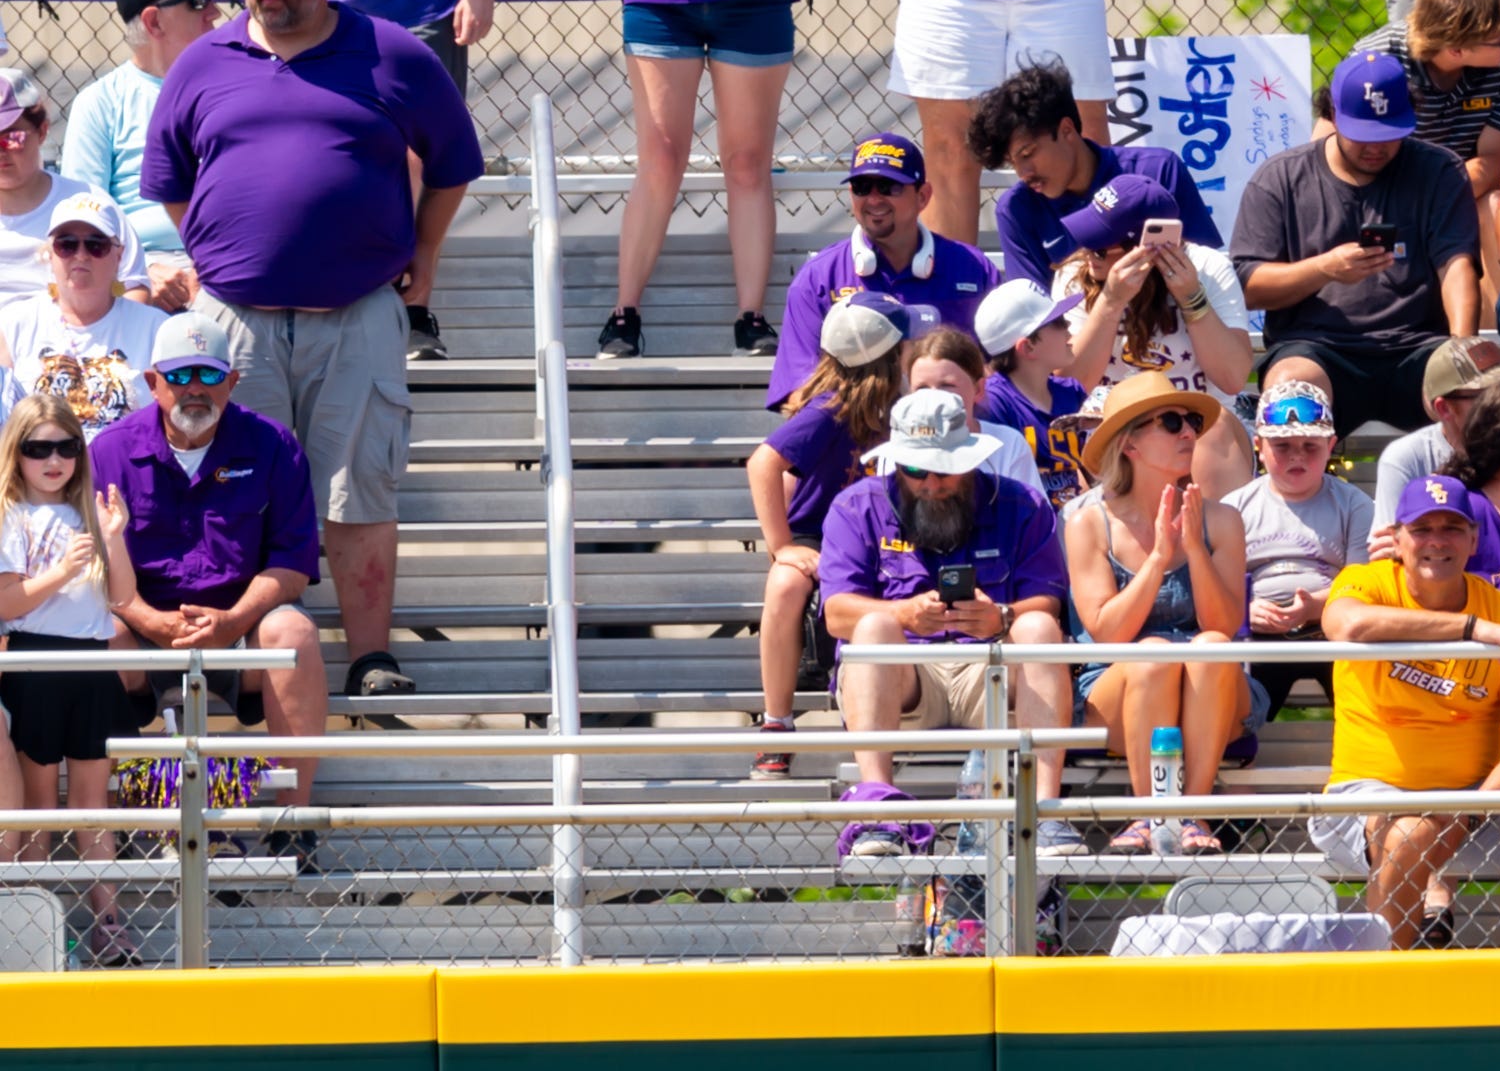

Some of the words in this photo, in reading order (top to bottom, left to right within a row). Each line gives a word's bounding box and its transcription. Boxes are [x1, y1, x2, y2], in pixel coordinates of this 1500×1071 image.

[1364, 82, 1389, 115] LSU
[1463, 97, 1491, 110] LSU
[880, 536, 914, 552] LSU
[1391, 662, 1456, 697] TIGERS
